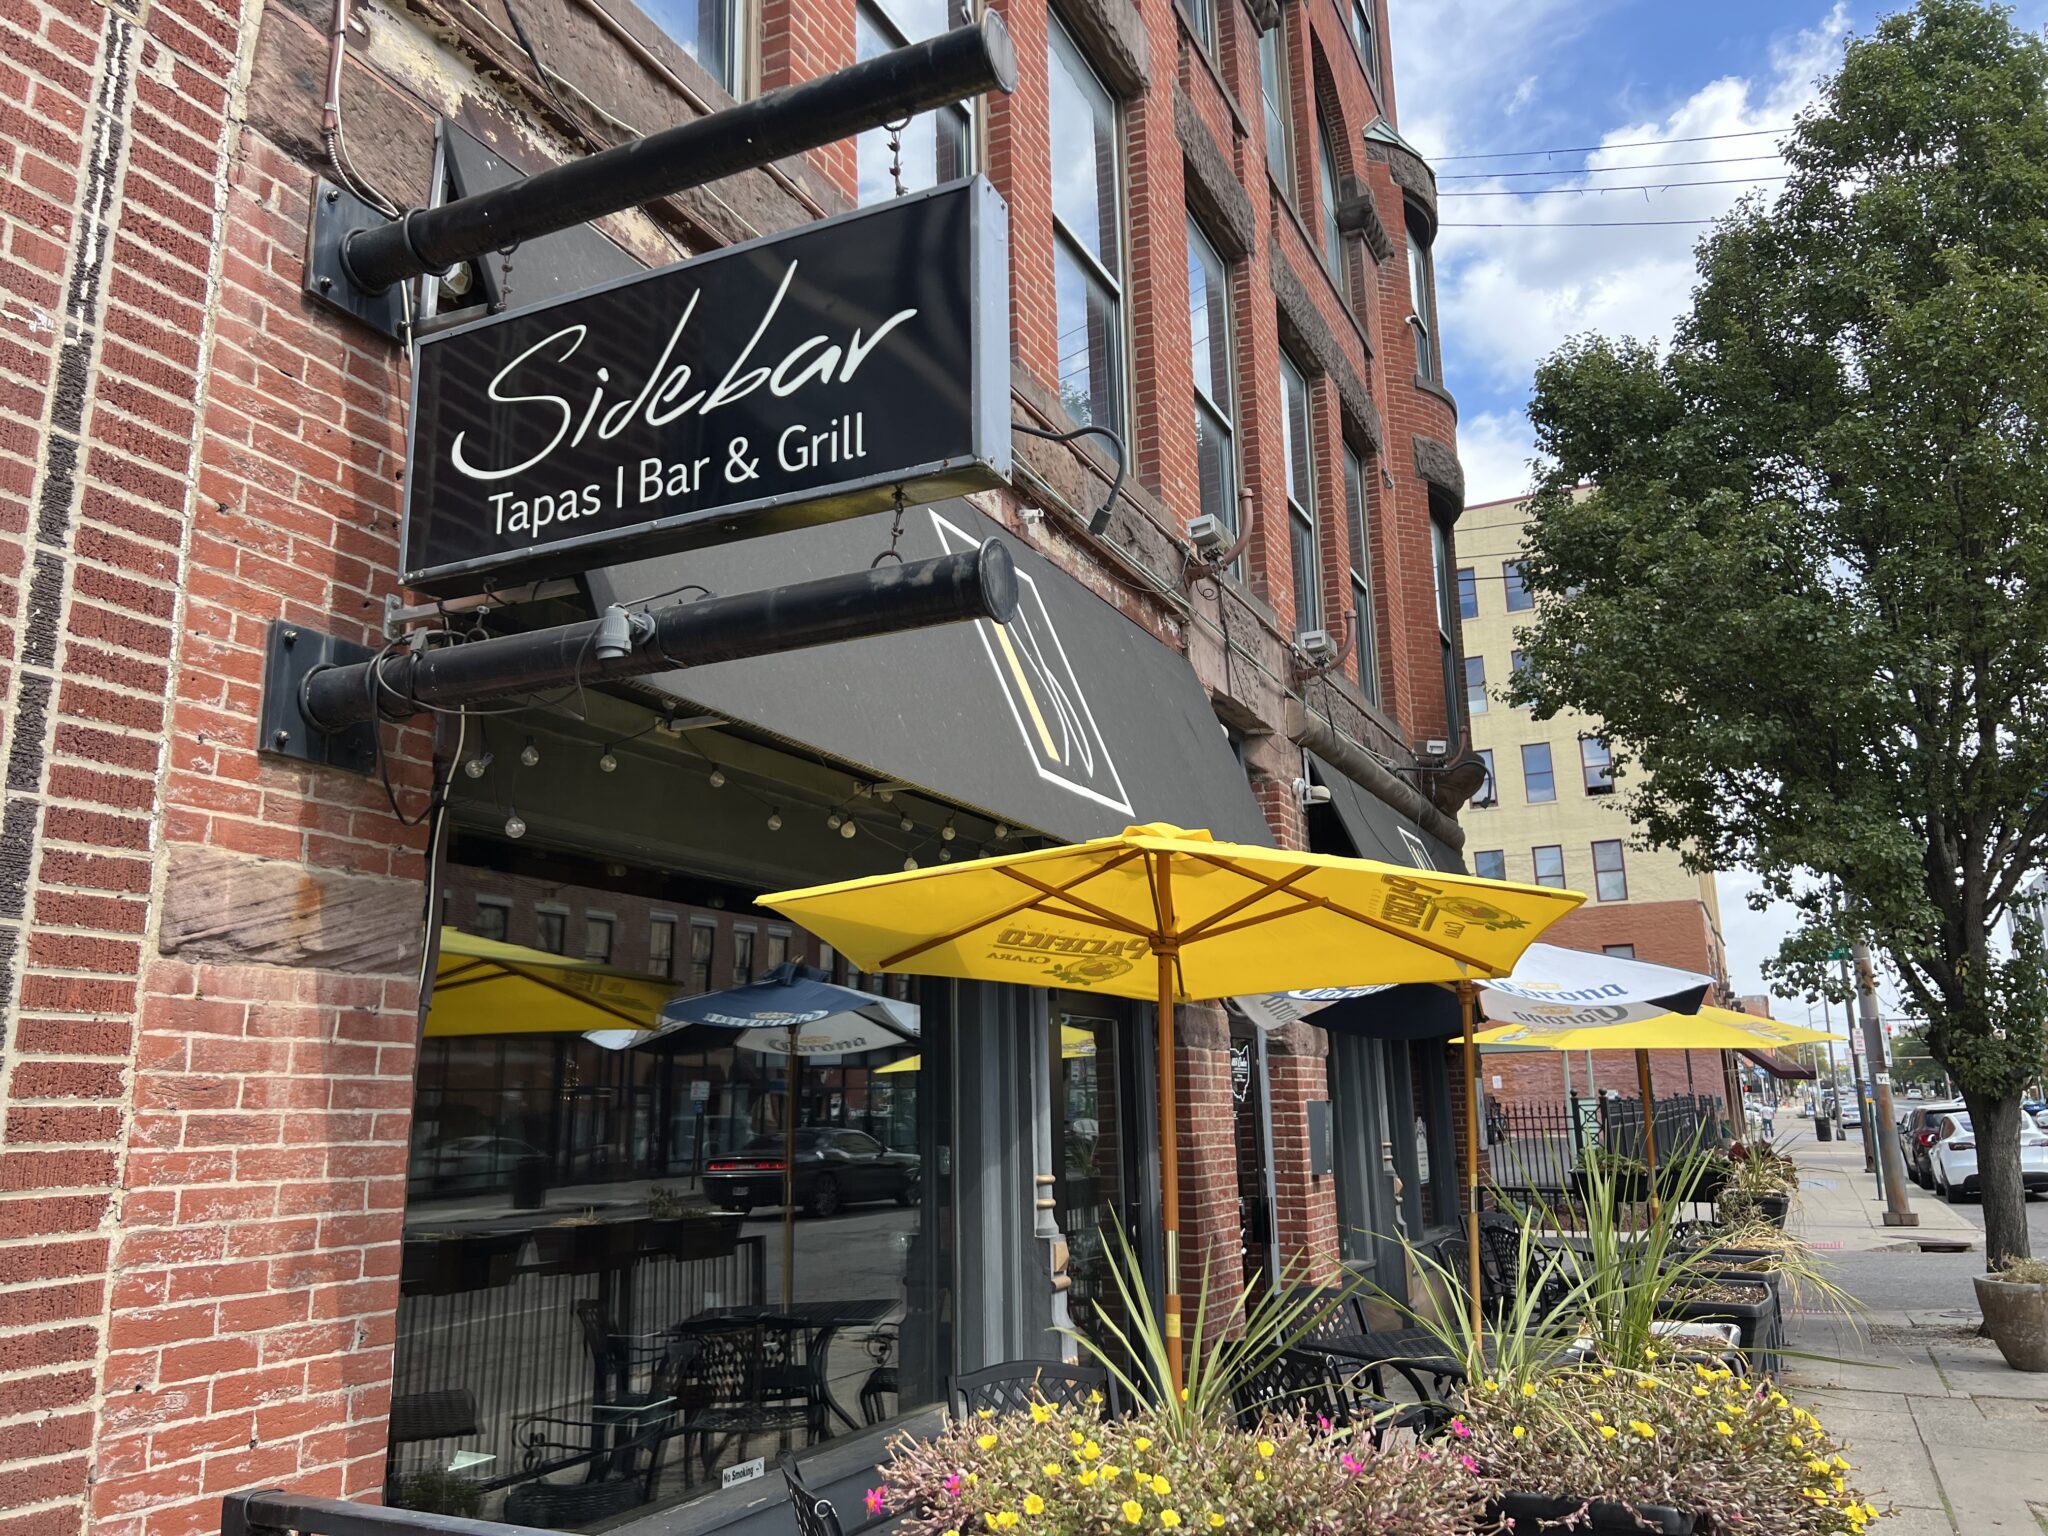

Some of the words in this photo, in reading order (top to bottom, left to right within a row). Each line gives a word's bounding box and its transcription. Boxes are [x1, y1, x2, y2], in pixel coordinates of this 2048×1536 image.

[451, 259, 917, 480] Sidebar
[488, 483, 601, 538] Tapas
[639, 455, 711, 503] Bar
[724, 436, 760, 484] &
[777, 411, 867, 472] Grill
[724, 1472, 731, 1483] No
[732, 1466, 753, 1480] Smoking
